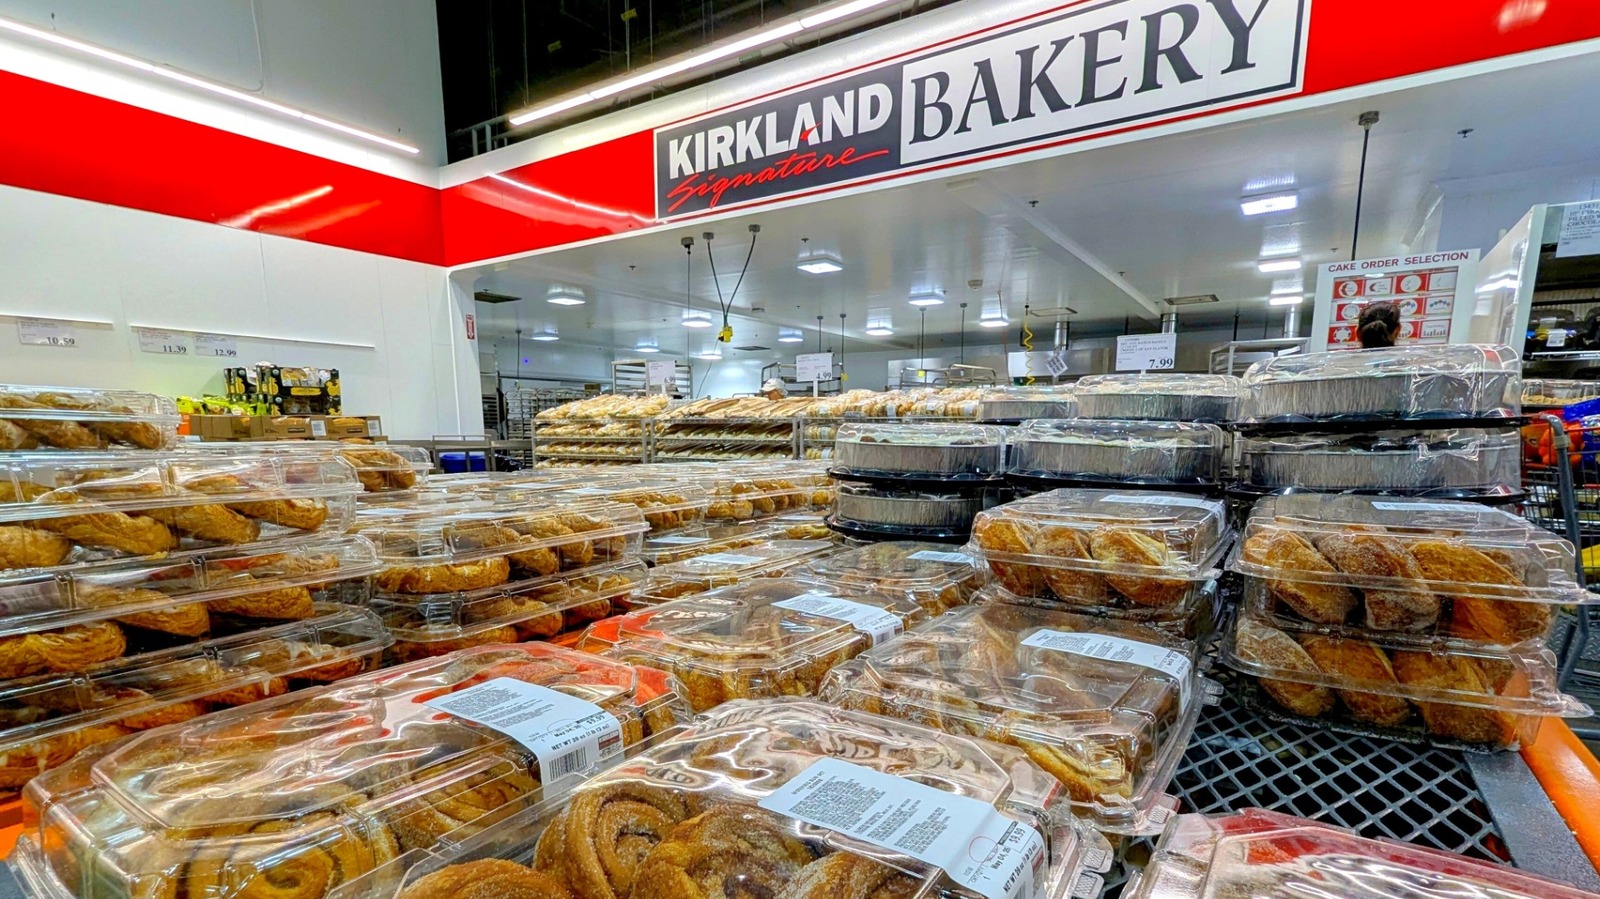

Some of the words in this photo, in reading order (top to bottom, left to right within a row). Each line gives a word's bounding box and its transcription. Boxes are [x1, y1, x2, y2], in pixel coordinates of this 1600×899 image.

[908, 0, 1271, 145] BAKERY
[669, 83, 893, 179] KIRKLAND
[667, 147, 888, 212] Signature
[1328, 263, 1357, 273] CAKE
[1361, 258, 1399, 270] ORDER
[1404, 251, 1469, 266] SELECTION
[47, 336, 75, 345] 10.59
[162, 344, 187, 354] 11.39
[214, 348, 237, 357] 12.99
[1149, 358, 1173, 368] 7.99
[816, 371, 832, 380] 4.99
[551, 743, 563, 751] NET
[1009, 827, 1026, 844] $9.99
[991, 859, 1003, 870] May
[1003, 880, 1012, 893] NET
